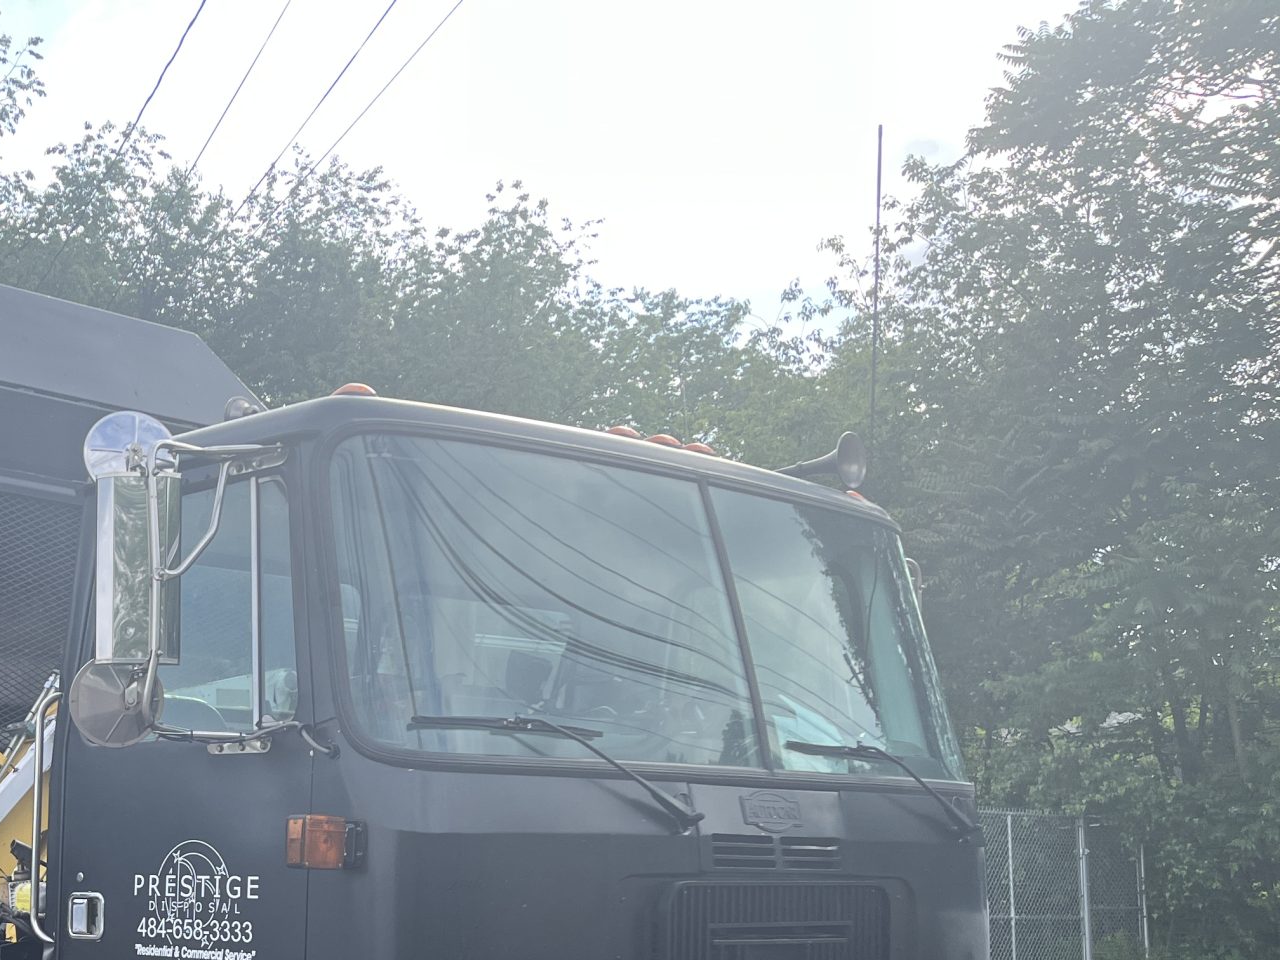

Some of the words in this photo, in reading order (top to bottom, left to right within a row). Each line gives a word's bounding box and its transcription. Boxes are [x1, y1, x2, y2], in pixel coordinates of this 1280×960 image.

[133, 874, 260, 899] PRESTIGE
[148, 900, 241, 915] DISPOSAL
[136, 916, 253, 943] 484-658-3333
[174, 945, 181, 958] &
[181, 946, 224, 960] Commercial
